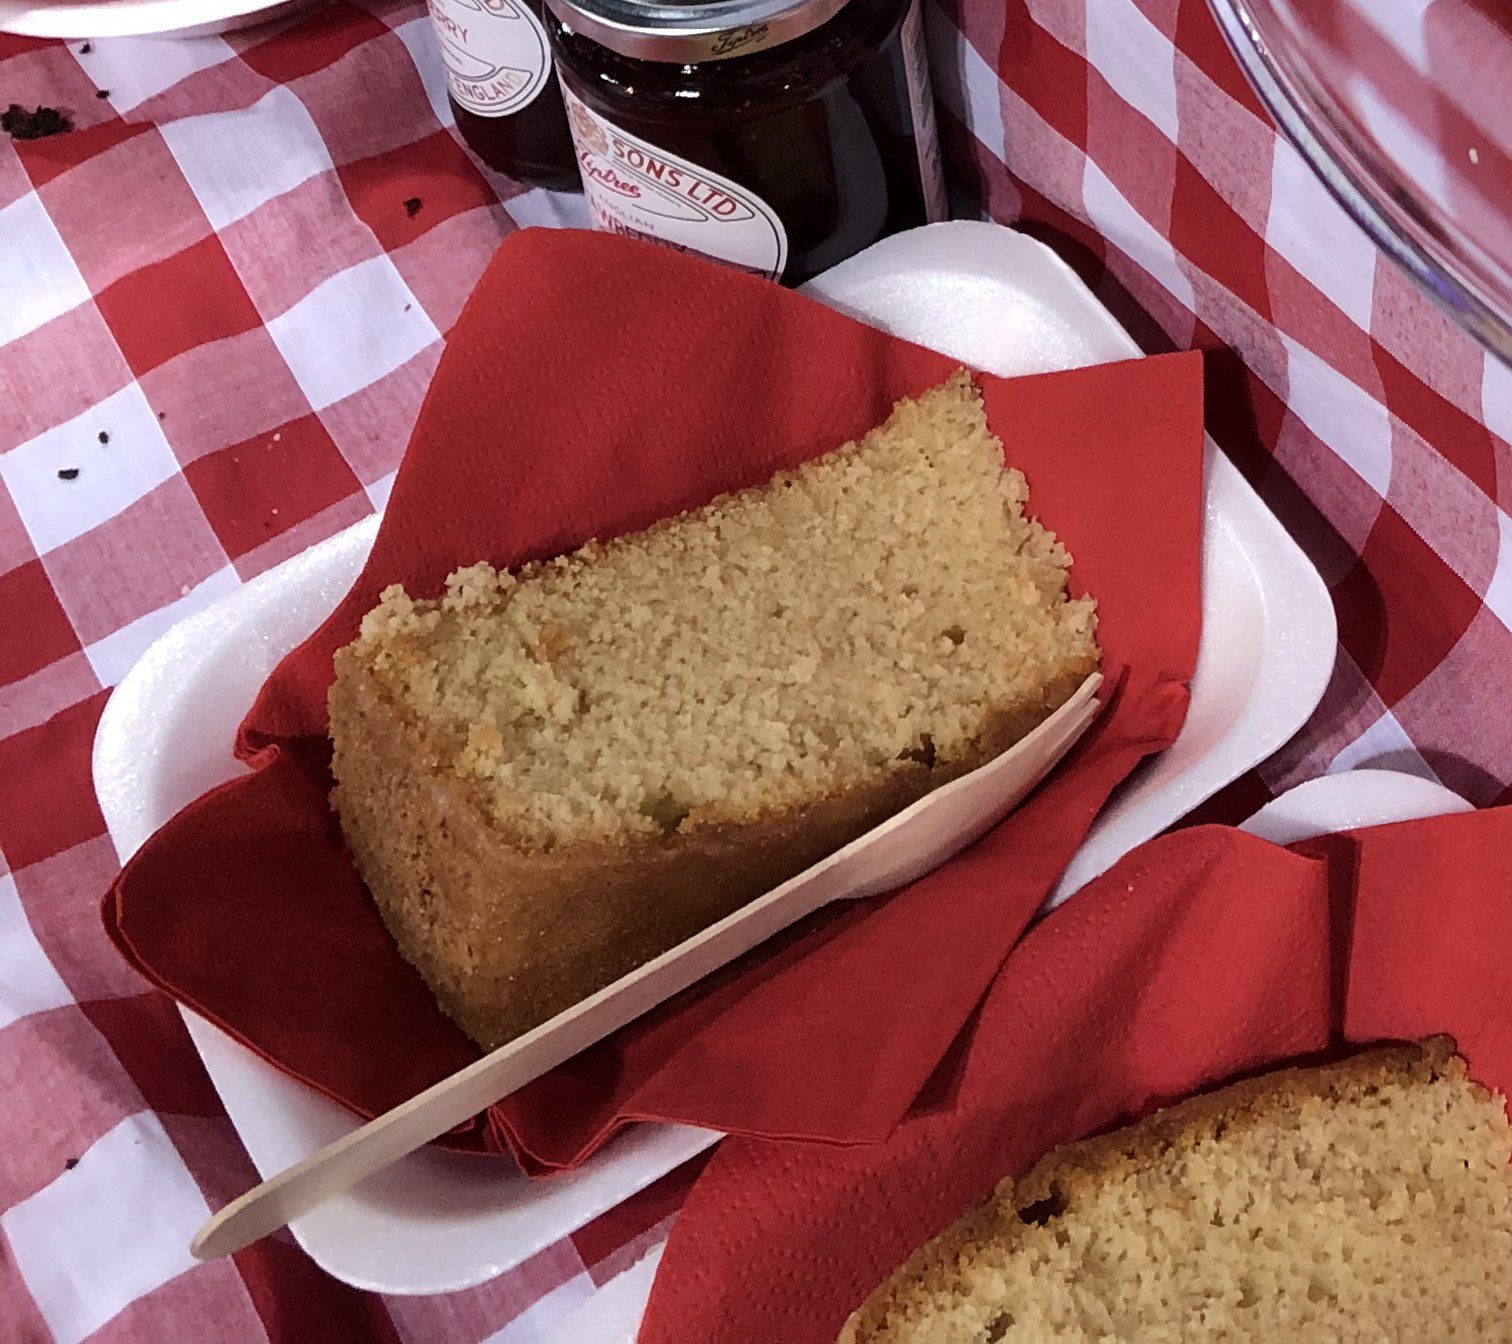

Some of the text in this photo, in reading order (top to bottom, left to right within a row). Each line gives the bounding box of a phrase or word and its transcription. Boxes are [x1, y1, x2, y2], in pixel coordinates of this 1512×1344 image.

[453, 72, 522, 101] ENGLAND
[611, 138, 684, 188] SONS
[686, 179, 738, 216] LTD
